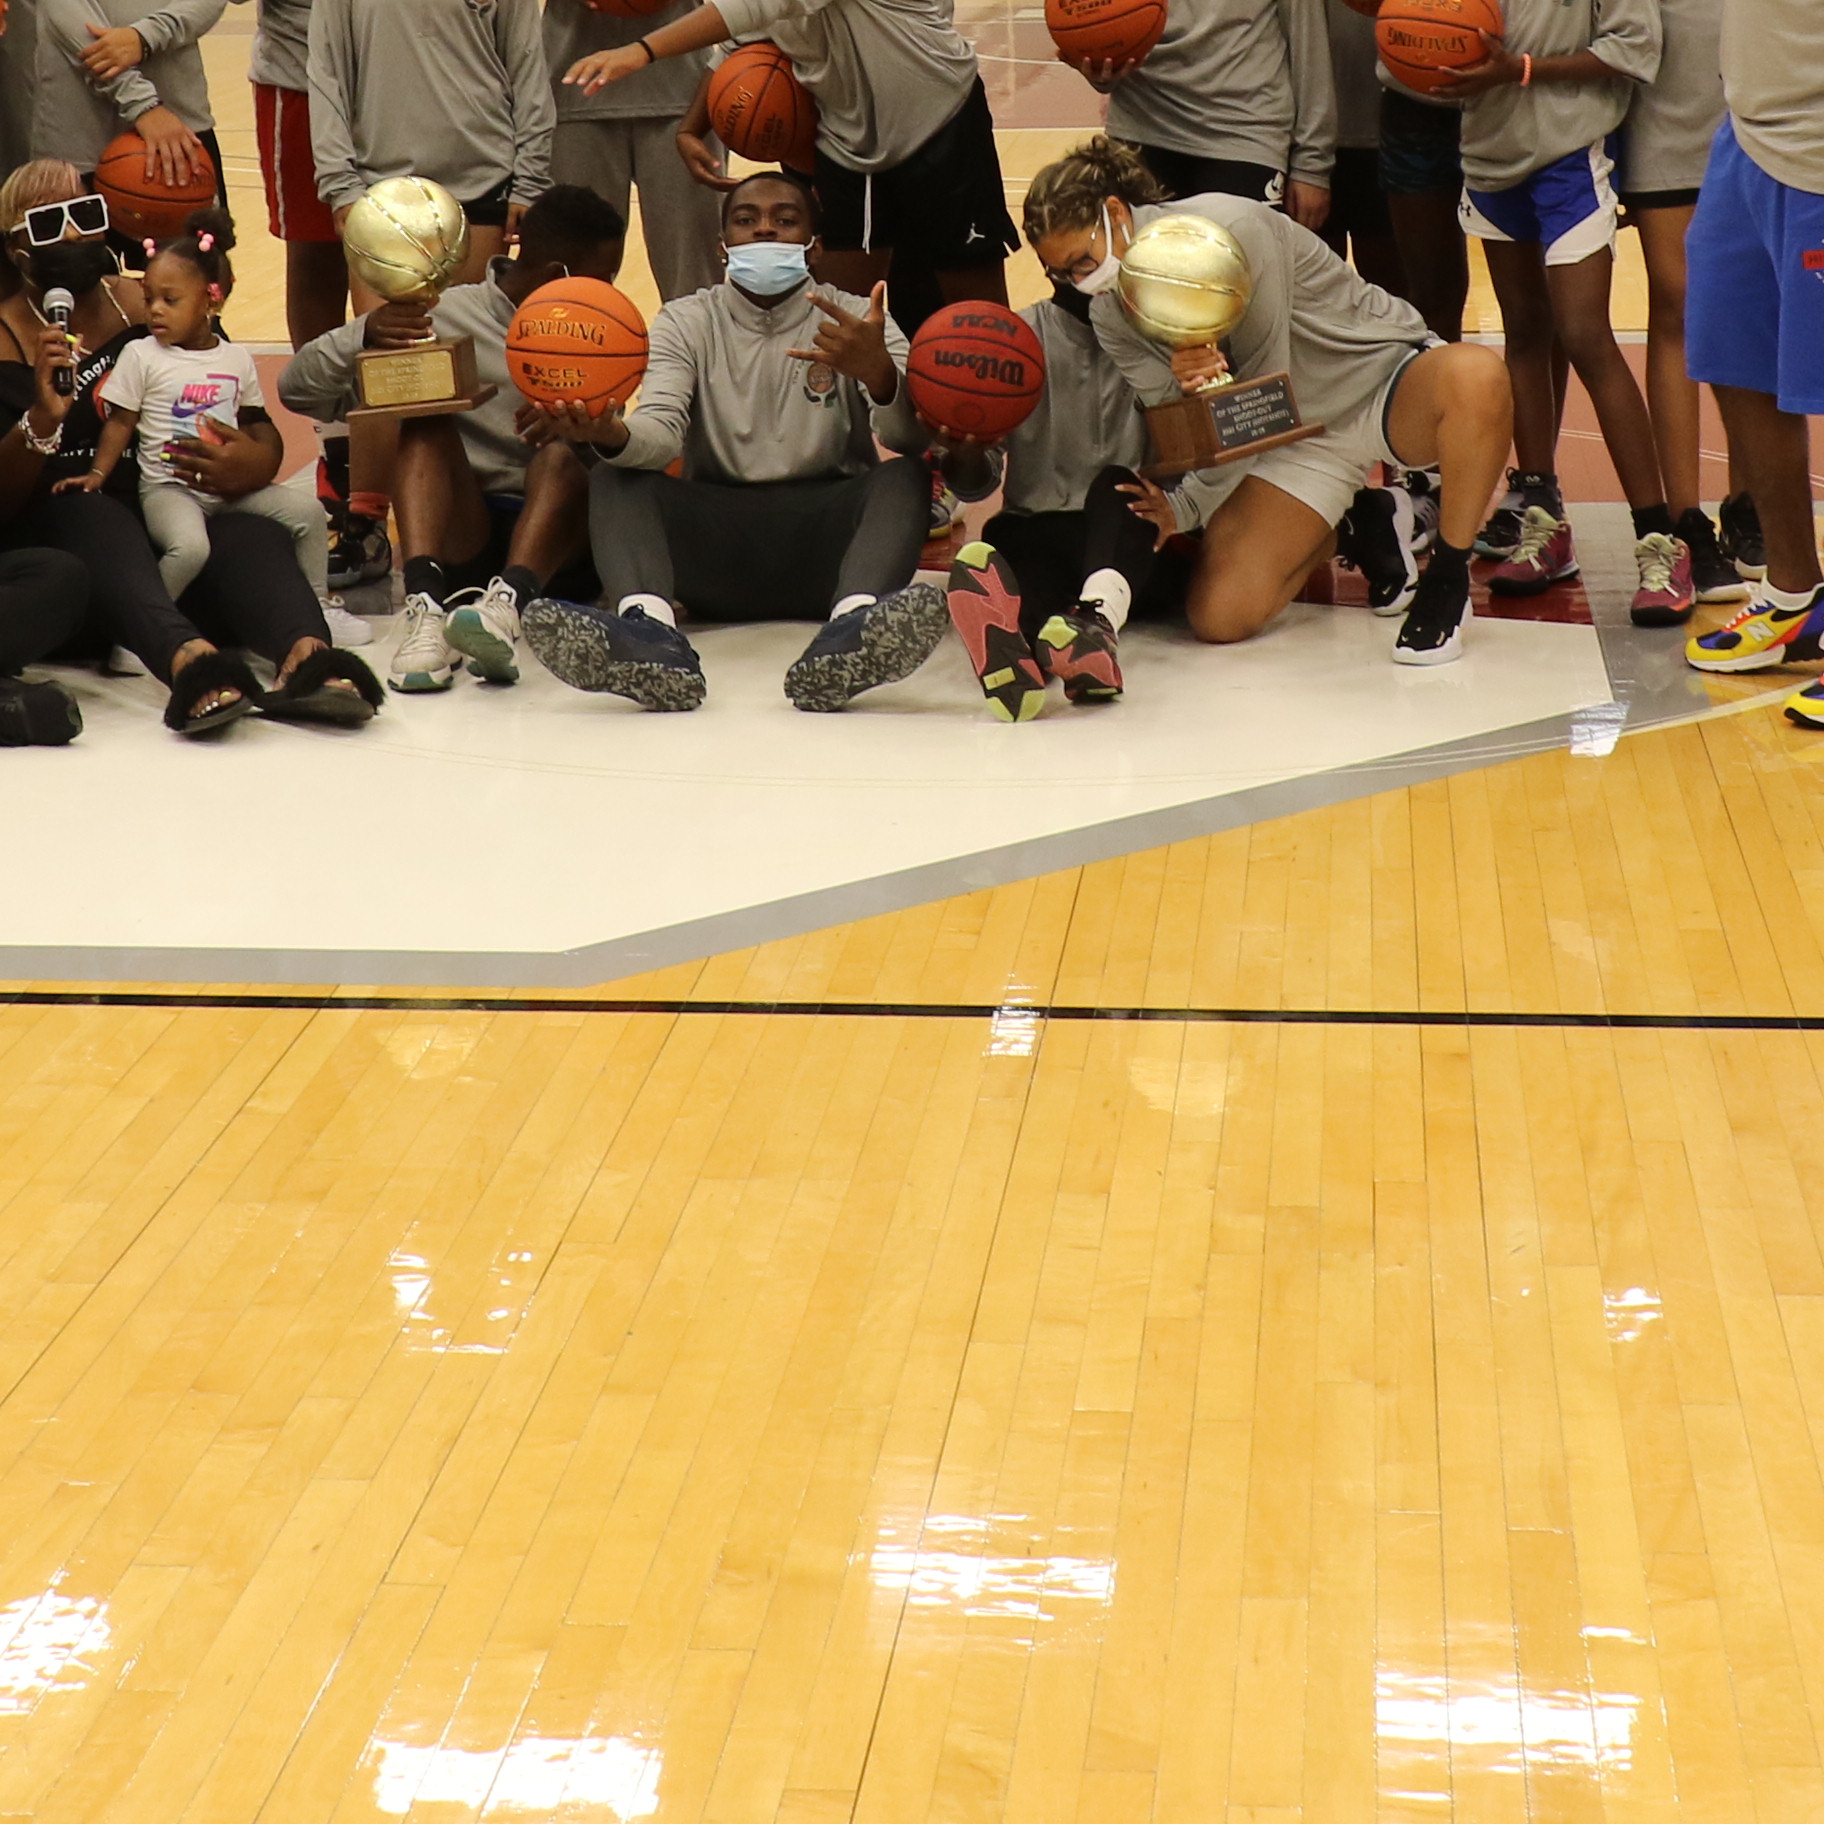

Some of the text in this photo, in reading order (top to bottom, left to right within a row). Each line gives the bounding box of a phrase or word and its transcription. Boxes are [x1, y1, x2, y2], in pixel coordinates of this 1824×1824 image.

[1387, 26, 1469, 54] SPALDING
[516, 319, 606, 347] SPALDING
[952, 313, 1018, 338] NCAA
[522, 362, 587, 378] EXCEL
[934, 348, 1025, 387] Wilson
[182, 383, 222, 403] NIKE
